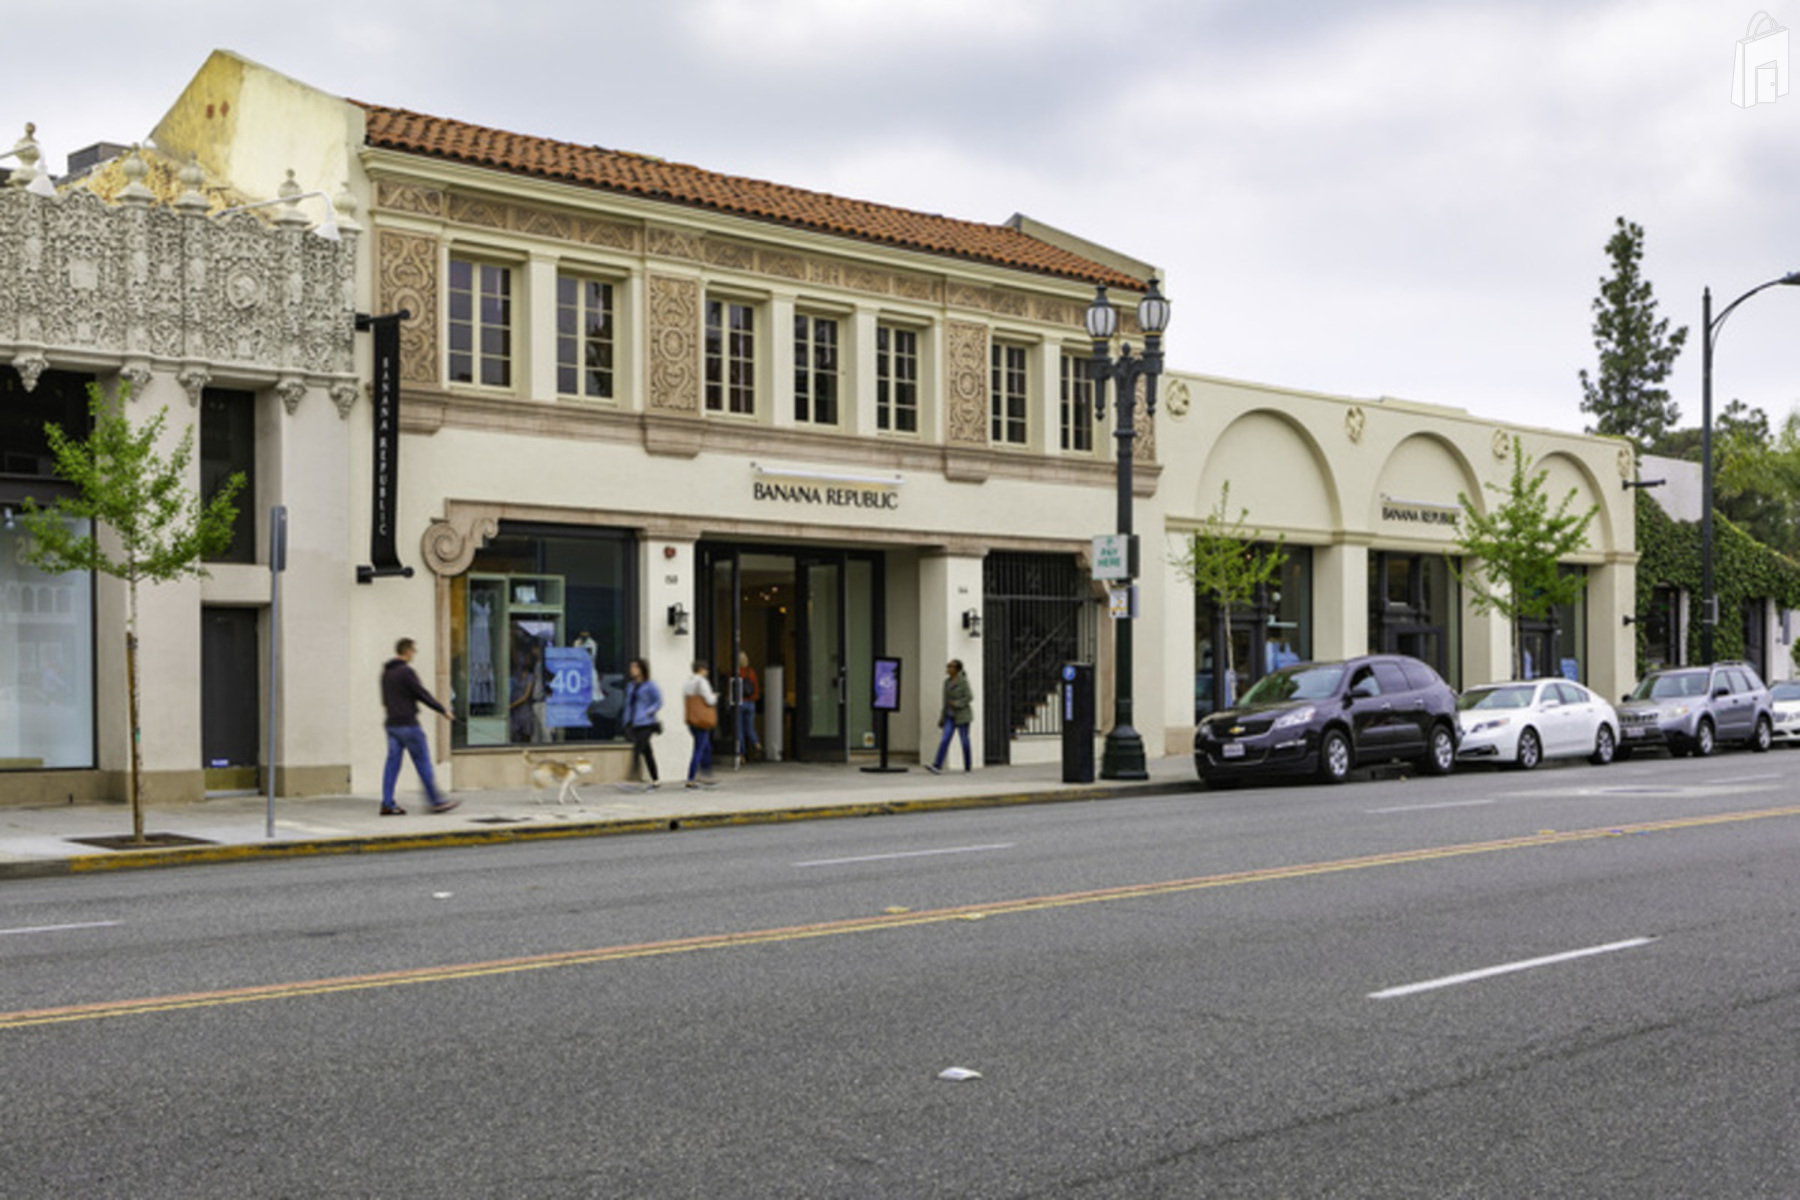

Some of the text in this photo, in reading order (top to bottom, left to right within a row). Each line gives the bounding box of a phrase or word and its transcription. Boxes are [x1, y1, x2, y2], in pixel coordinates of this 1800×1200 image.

[753, 482, 898, 510] BANANA REPUBLIC
[550, 669, 581, 693] 40
